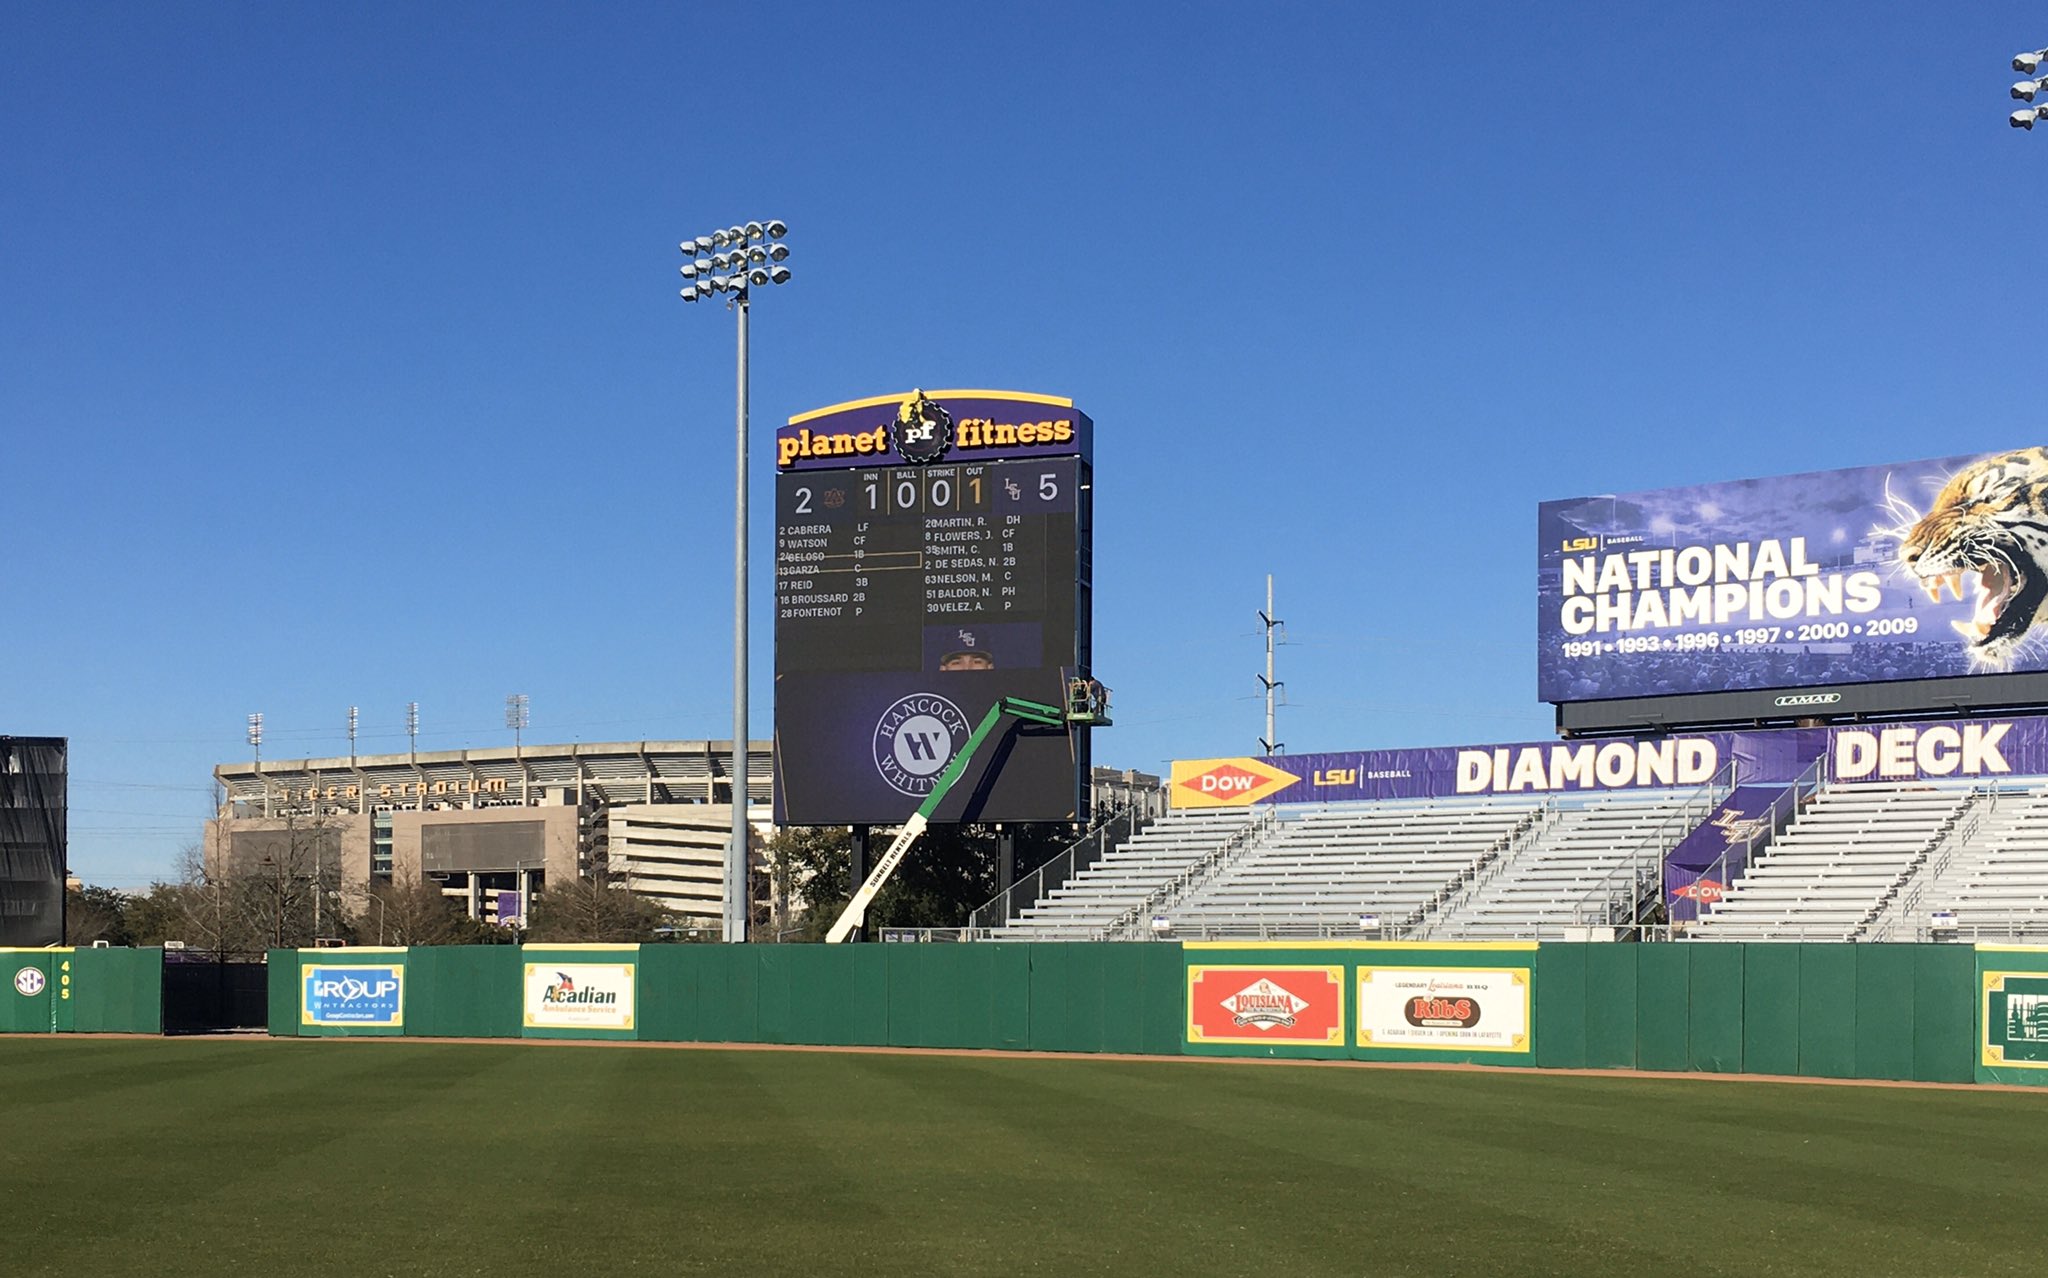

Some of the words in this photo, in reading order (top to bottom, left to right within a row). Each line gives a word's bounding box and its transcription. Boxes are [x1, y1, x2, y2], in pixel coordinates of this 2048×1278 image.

[905, 421, 936, 444] pf
[778, 425, 886, 465] planet
[956, 419, 1072, 447] fitness
[863, 473, 878, 481] INN
[896, 471, 917, 479] BALL
[927, 468, 955, 478] STRIKE
[966, 467, 983, 476] OUT
[795, 487, 812, 514] 2
[865, 484, 877, 510] 1
[897, 482, 916, 508] 0
[932, 479, 950, 507] 0
[969, 478, 981, 504] 1
[1039, 474, 1058, 500] 5
[977, 517, 987, 526] R.
[1006, 515, 1020, 524] DH
[779, 527, 785, 535] 2
[788, 525, 832, 535] CABRERA
[857, 523, 869, 532] LF
[925, 532, 931, 541] 8
[1002, 529, 1015, 538] CF
[779, 539, 785, 548] 9
[788, 538, 828, 549] WATSON
[853, 536, 866, 545] CF
[1002, 543, 1014, 552] 1B
[1562, 536, 1598, 552] LSU
[1607, 535, 1644, 545] BASEBALL
[854, 550, 865, 559] 1B
[779, 567, 788, 576] 13
[789, 565, 820, 575] GARZA
[854, 564, 861, 572] C
[925, 561, 931, 570] 2
[935, 560, 948, 569] DE
[951, 558, 986, 568] SEDAS,
[1003, 557, 1016, 566] 2B
[1562, 536, 1819, 596] NATIONAL
[1004, 571, 1012, 580] C
[779, 581, 788, 590] 17
[790, 580, 813, 590] REID
[855, 577, 869, 587] 3B
[791, 593, 849, 605] BROUSSARD
[853, 593, 866, 602] 2B
[926, 590, 936, 599] 51
[1002, 587, 1016, 596] PH
[927, 603, 939, 613] 30
[1004, 602, 1012, 610] P
[1560, 571, 1882, 635] CHAMPIONS
[781, 609, 792, 618] 28
[793, 607, 842, 618] FONTENOT
[855, 607, 863, 616] P
[1562, 639, 1601, 658] 1991
[1616, 635, 1660, 654] 1993
[1674, 632, 1720, 650] 1996
[1735, 627, 1781, 645] 1997
[1797, 622, 1849, 641] 2000
[1866, 617, 1918, 636] 2009
[1779, 693, 1834, 706] LAMAR
[880, 699, 965, 740] HANCOCK
[1314, 769, 1355, 786] LSU
[1368, 769, 1411, 779] BASEBALL
[1456, 738, 1718, 793] DIAMOND
[1836, 723, 2013, 779] DECK
[281, 784, 358, 802] TIGER
[380, 778, 506, 798] STADIUM
[870, 860, 892, 887] SUNBELT
[891, 832, 913, 860] RENTALS
[17, 969, 43, 994] SEC
[542, 985, 617, 1004] Acadian
[587, 1005, 617, 1014] Service
[1235, 995, 1294, 1014] LOUISIANA
